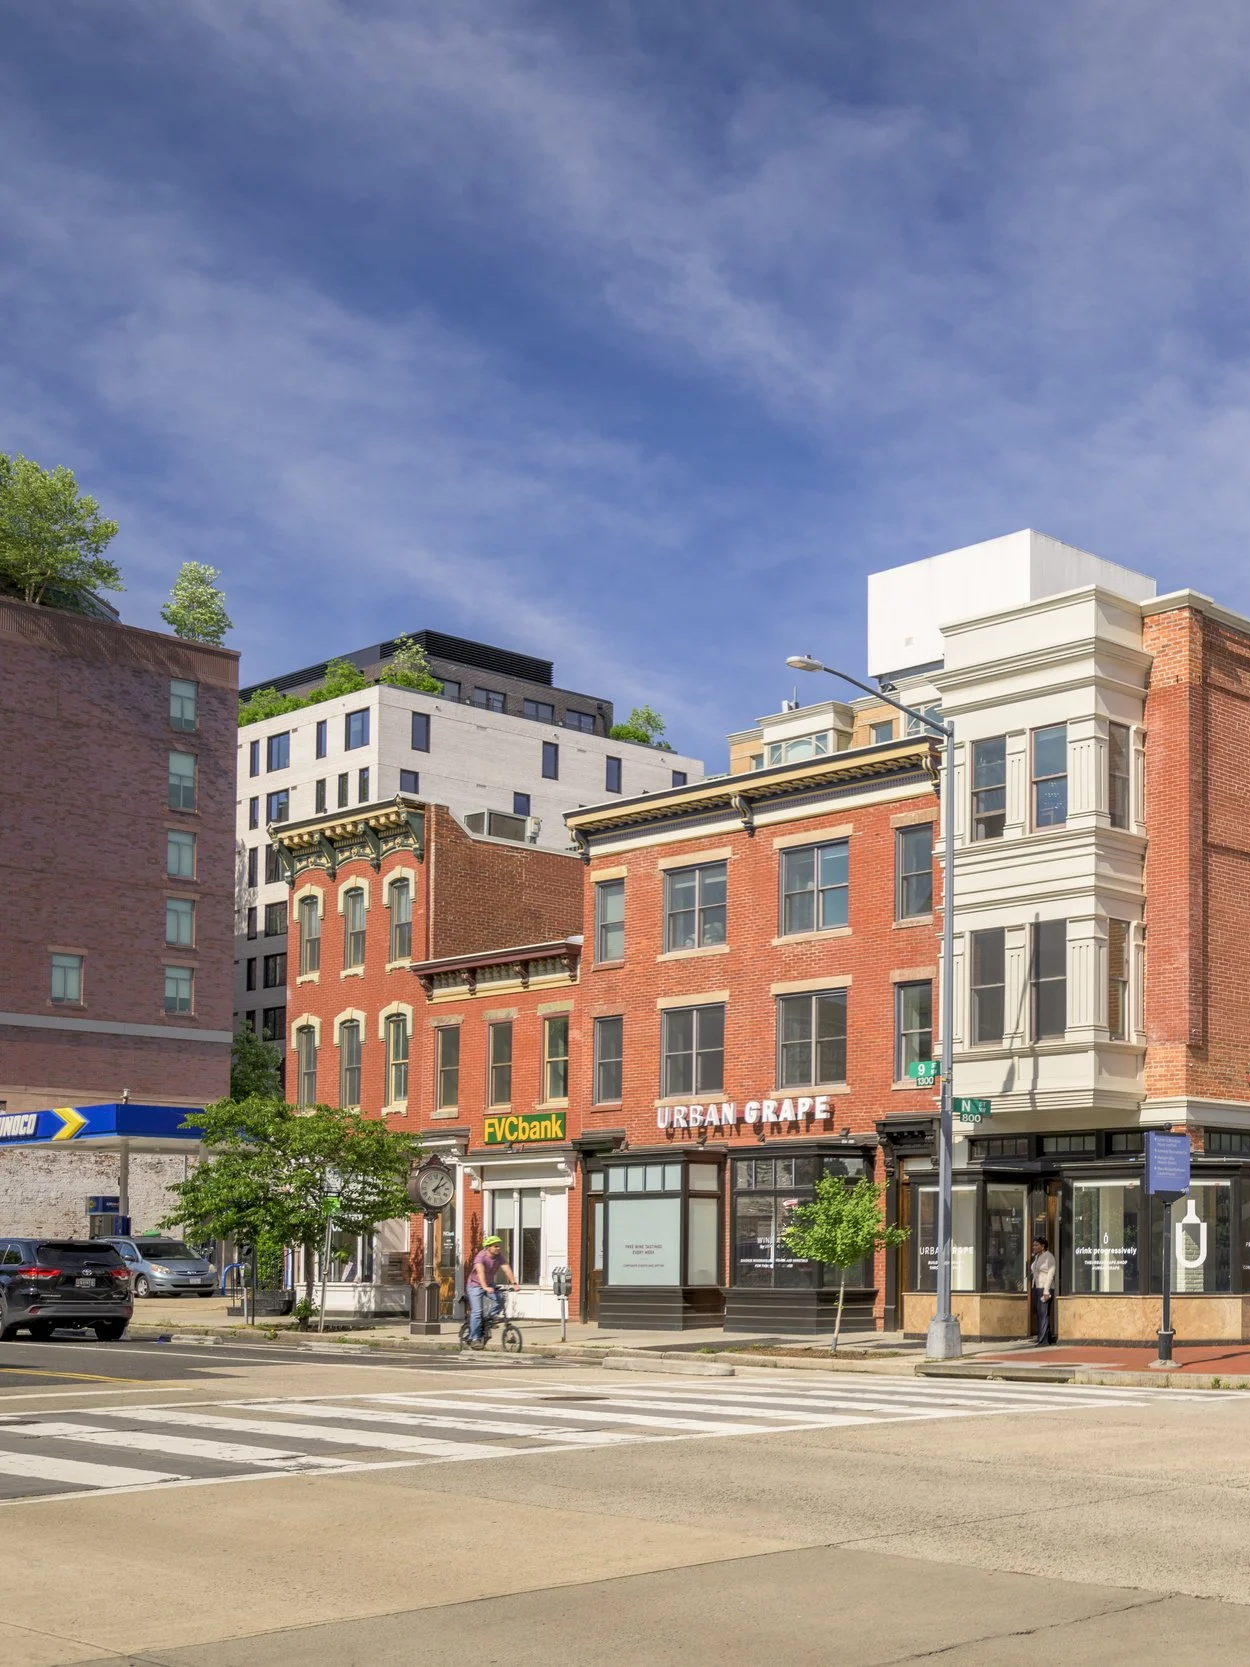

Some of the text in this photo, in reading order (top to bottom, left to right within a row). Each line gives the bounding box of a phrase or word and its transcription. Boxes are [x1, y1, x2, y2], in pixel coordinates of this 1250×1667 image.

[917, 1063, 926, 1076] 9
[917, 1076, 934, 1085] 1300
[657, 1096, 831, 1128] URBAN GRAPE
[961, 1100, 971, 1112] N
[962, 1113, 981, 1122] 800
[484, 1114, 563, 1142] FVCbank
[1075, 1246, 1137, 1256] drink progressively
